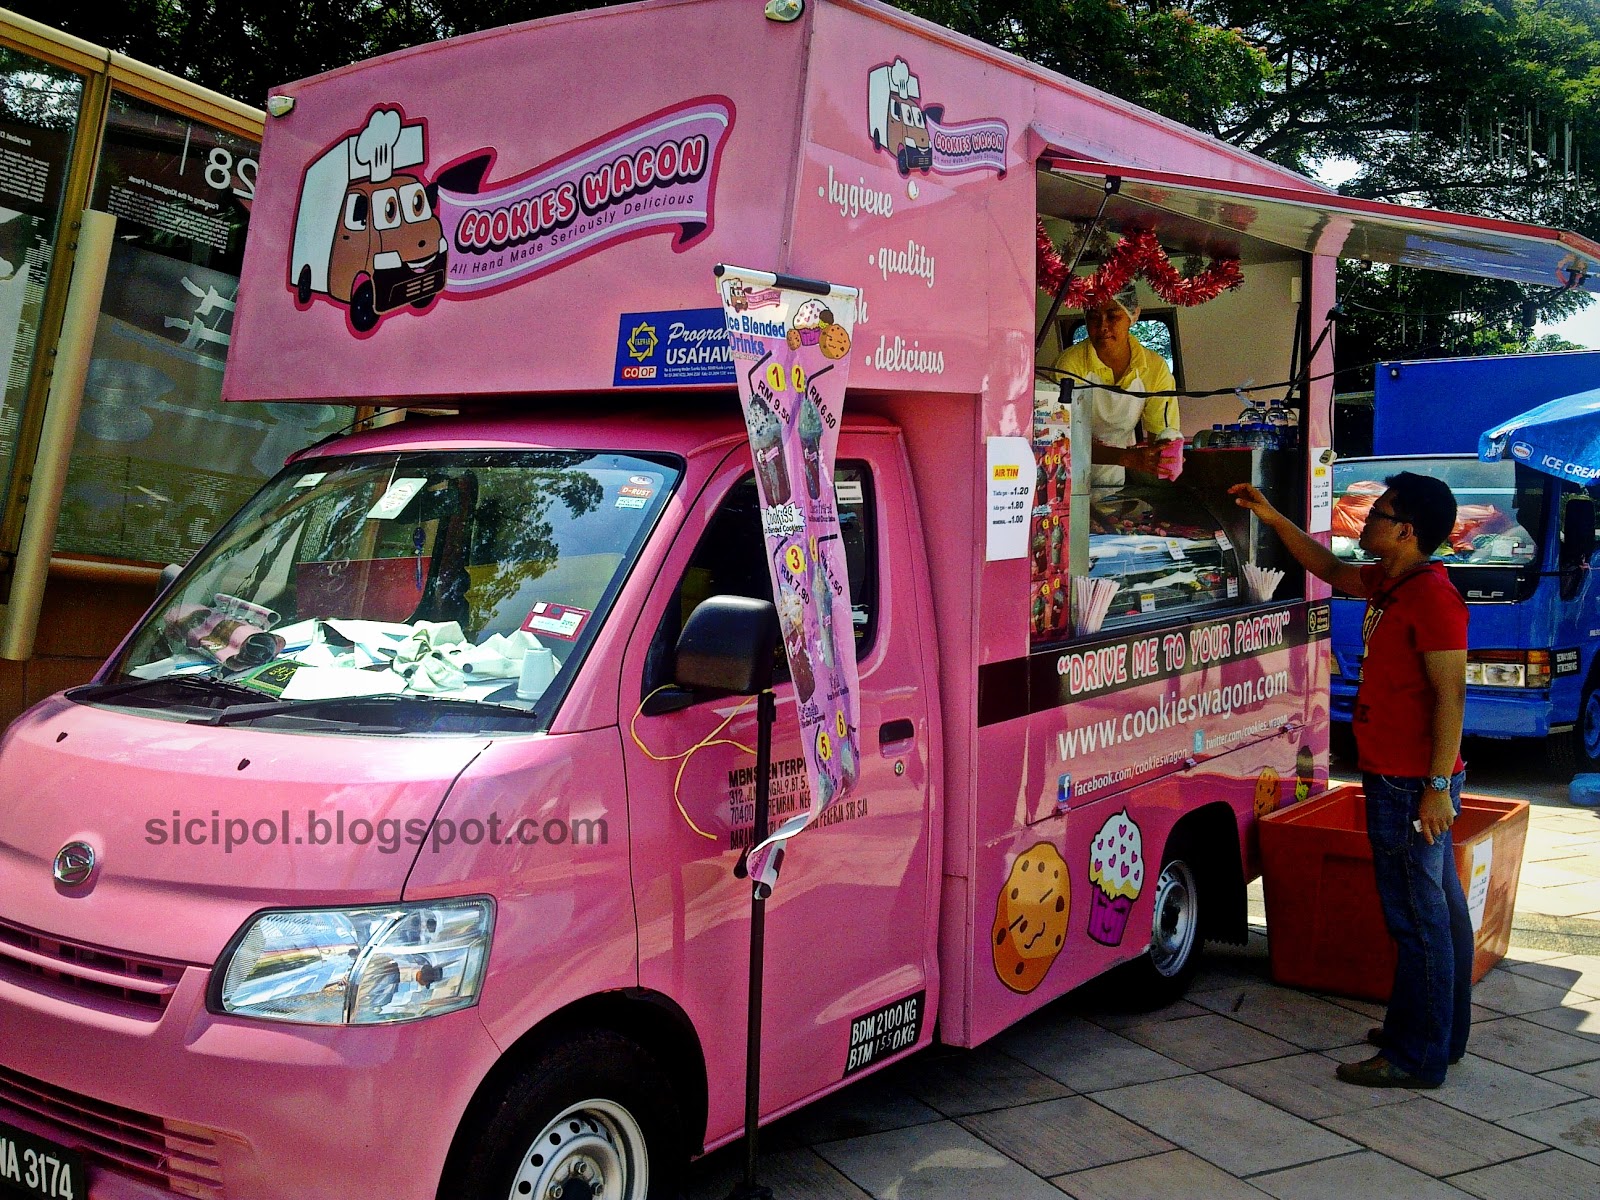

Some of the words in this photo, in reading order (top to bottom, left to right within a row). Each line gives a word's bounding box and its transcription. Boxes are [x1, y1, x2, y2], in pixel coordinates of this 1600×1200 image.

[934, 131, 972, 156] COOKIES
[972, 131, 1004, 153] WAGON
[455, 181, 577, 252] COOKIES
[577, 134, 708, 215] WAGON
[828, 165, 894, 218] hygiene
[450, 263, 467, 274] All
[472, 257, 503, 273] Hand
[510, 243, 544, 263] Made
[550, 211, 615, 246] Seriously
[624, 193, 694, 215] Delicious
[878, 240, 935, 288] quality
[742, 316, 785, 338] Blended
[729, 331, 765, 355] Drinks
[875, 336, 944, 375] delicious
[772, 366, 780, 388] 1
[795, 367, 802, 388] 2
[758, 380, 773, 403] RM
[774, 399, 790, 424] 9.50
[809, 386, 822, 408] RM
[820, 405, 837, 429] 6.50
[995, 469, 1005, 477] AIR
[1007, 469, 1019, 477] TIN
[1541, 455, 1563, 470] ICE
[791, 548, 800, 570] 3
[828, 570, 843, 595] 7.50
[1467, 590, 1504, 598] ELF
[1133, 637, 1158, 679] ME
[1163, 632, 1185, 671] TO
[1190, 623, 1230, 664] YOUR
[1058, 670, 1288, 761] www.cookieswagon.com
[821, 736, 828, 758] 5
[1074, 748, 1187, 797] facebook.com/cookieswagon
[730, 804, 754, 825] 70400
[852, 1016, 875, 1046] BDM
[876, 1005, 902, 1035] 2100
[903, 998, 916, 1024] KG
[848, 1041, 873, 1071] BTM
[24, 1149, 73, 1200] 3174
